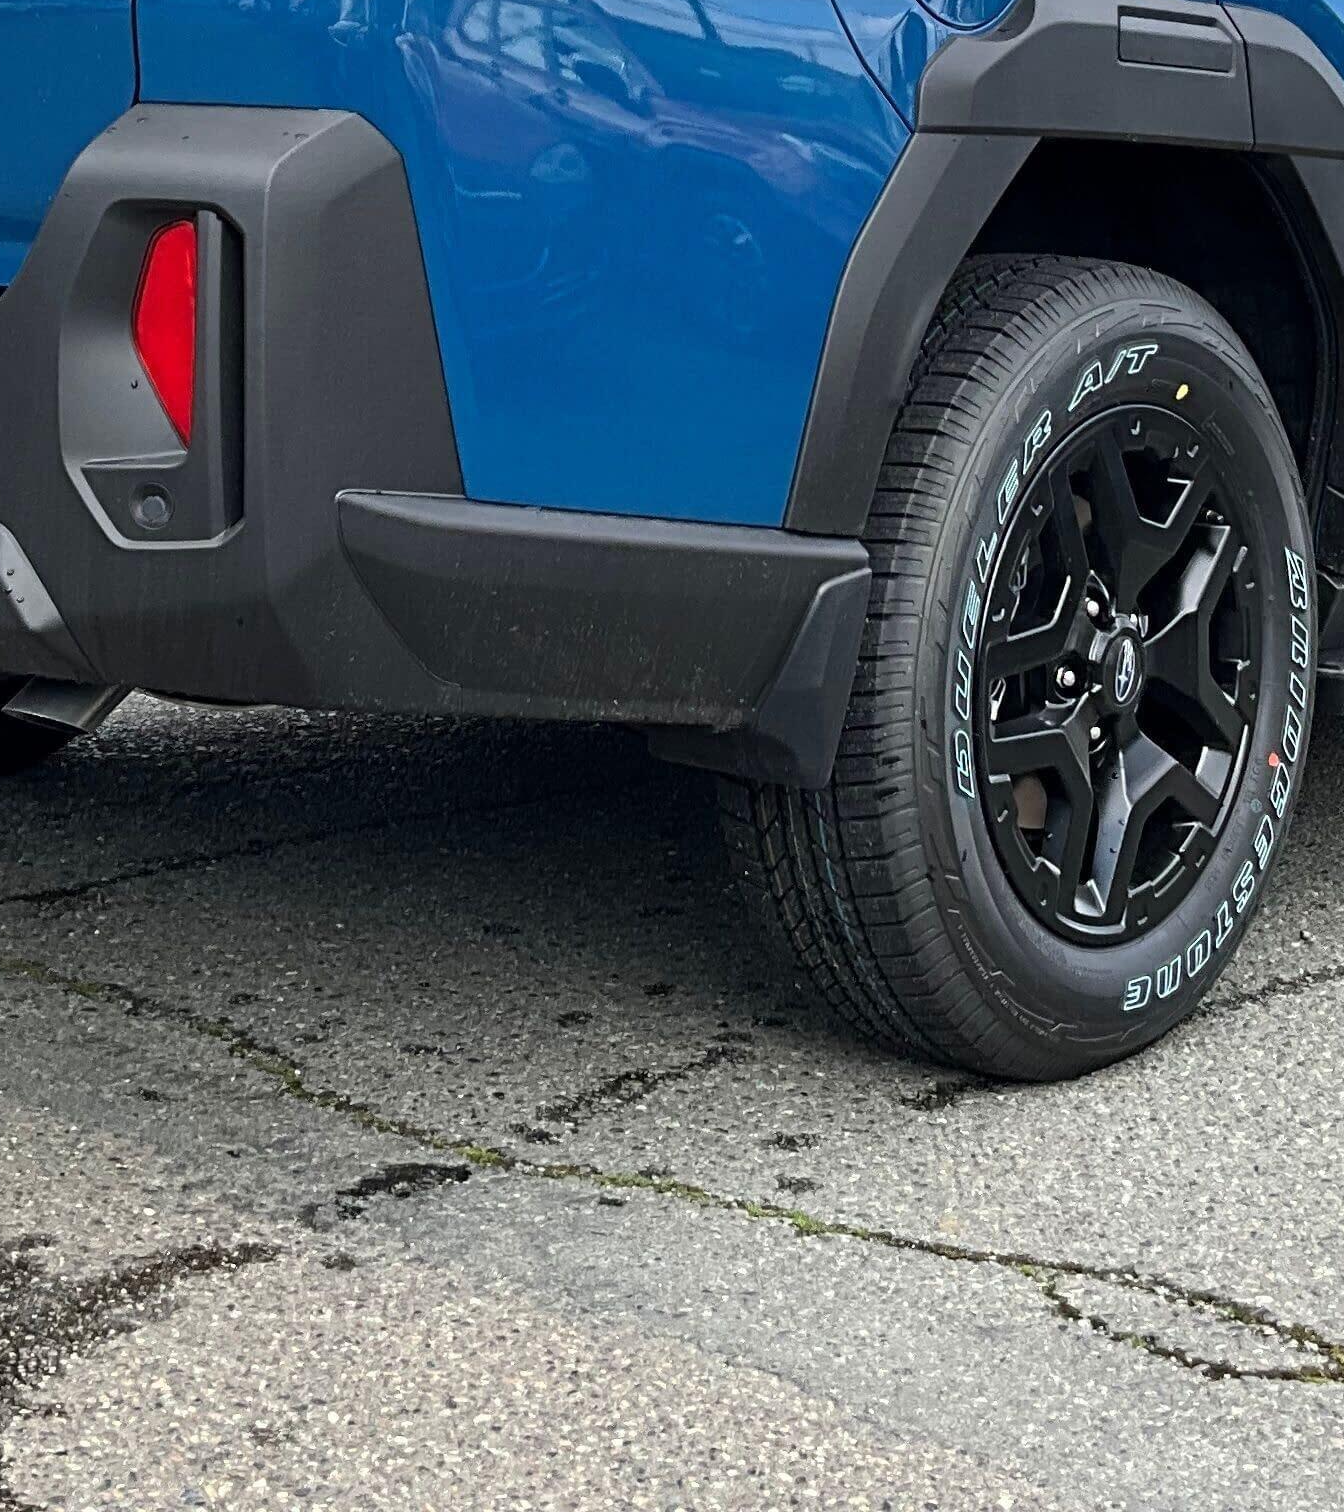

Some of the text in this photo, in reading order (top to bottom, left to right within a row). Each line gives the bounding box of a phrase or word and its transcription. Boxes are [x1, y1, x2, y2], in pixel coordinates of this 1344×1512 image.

[955, 343, 1159, 799] DUELER A/T
[1122, 546, 1309, 1012] BRIDGESTONE
